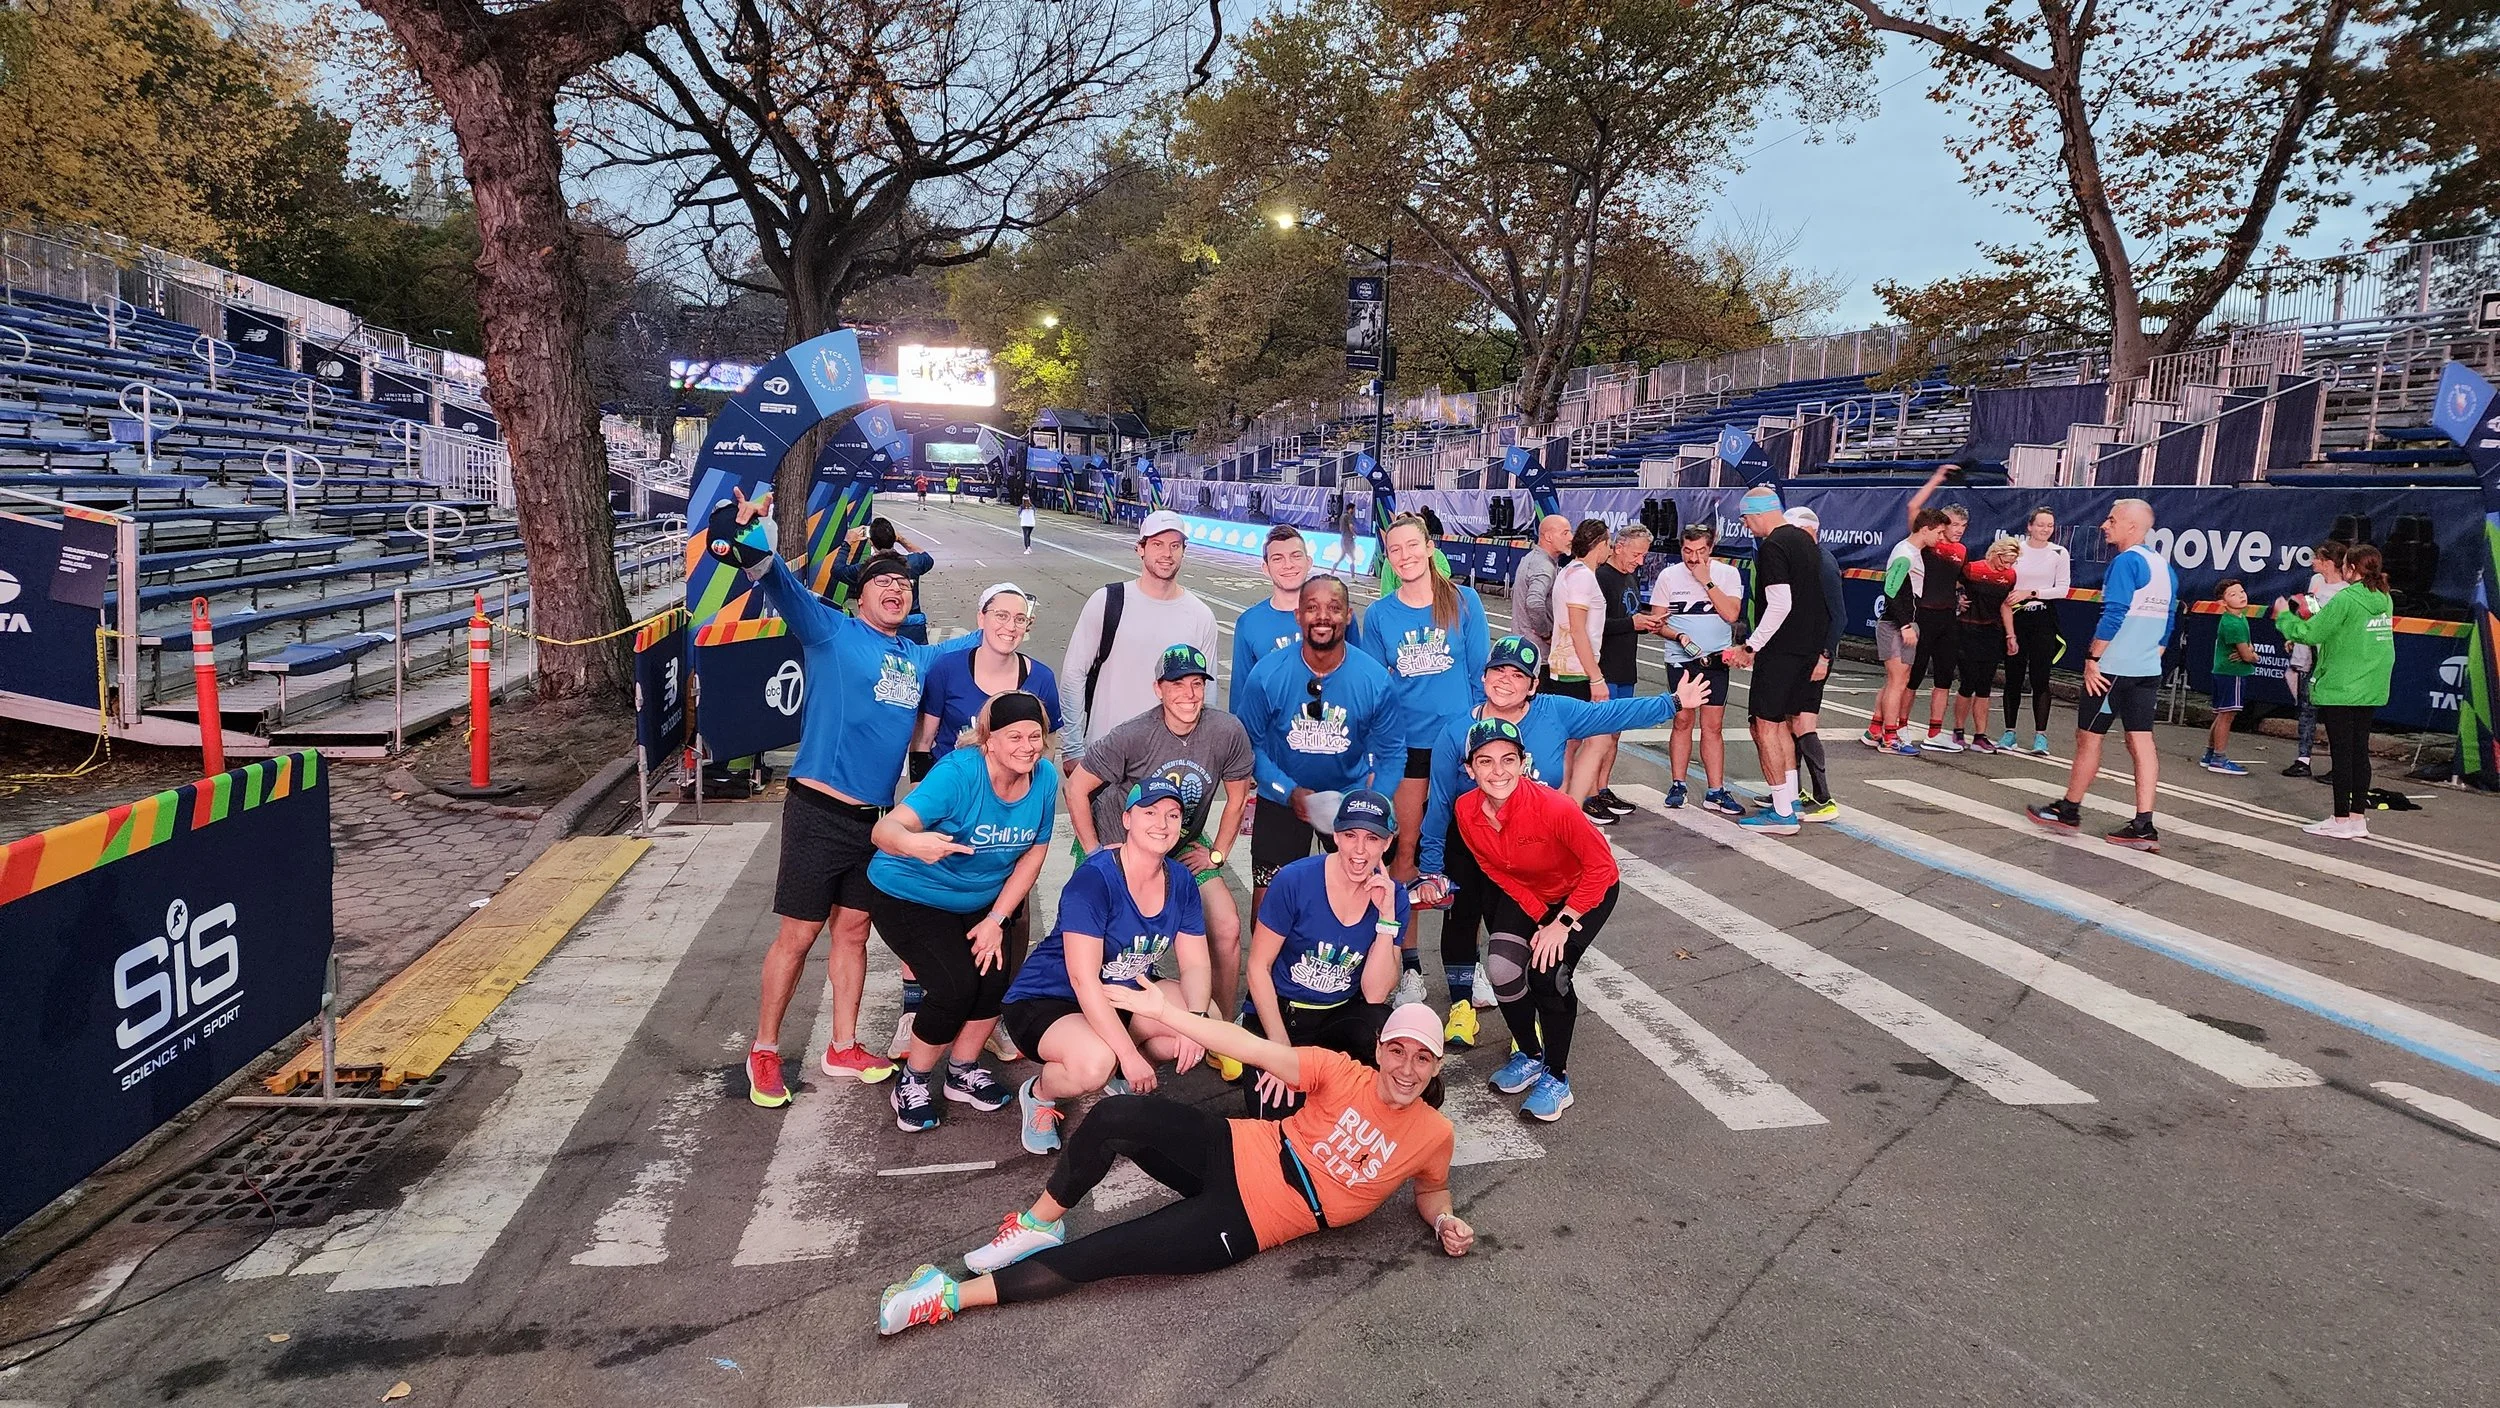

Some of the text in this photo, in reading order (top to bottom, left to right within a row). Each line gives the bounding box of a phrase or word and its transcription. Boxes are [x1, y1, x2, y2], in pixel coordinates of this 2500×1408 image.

[760, 402, 797, 414] ESPN
[1819, 529, 1883, 545] MARATHON
[62, 546, 109, 559] GRANDSTAND
[60, 559, 92, 569] HOLDERS
[1405, 642, 1444, 656] TEAM
[2254, 644, 2276, 654] TATA
[887, 668, 917, 688] TEAM
[2254, 667, 2284, 678] ERVICES
[766, 685, 781, 697] abc
[1300, 720, 1340, 734] TEAM
[1162, 759, 1185, 771] MENTAL
[1186, 760, 1206, 776] HEALTH
[121, 1004, 241, 1092] SCIENCE IN SPORT
[1338, 1107, 1397, 1163] RUN
[1312, 1141, 1368, 1188] CITY
